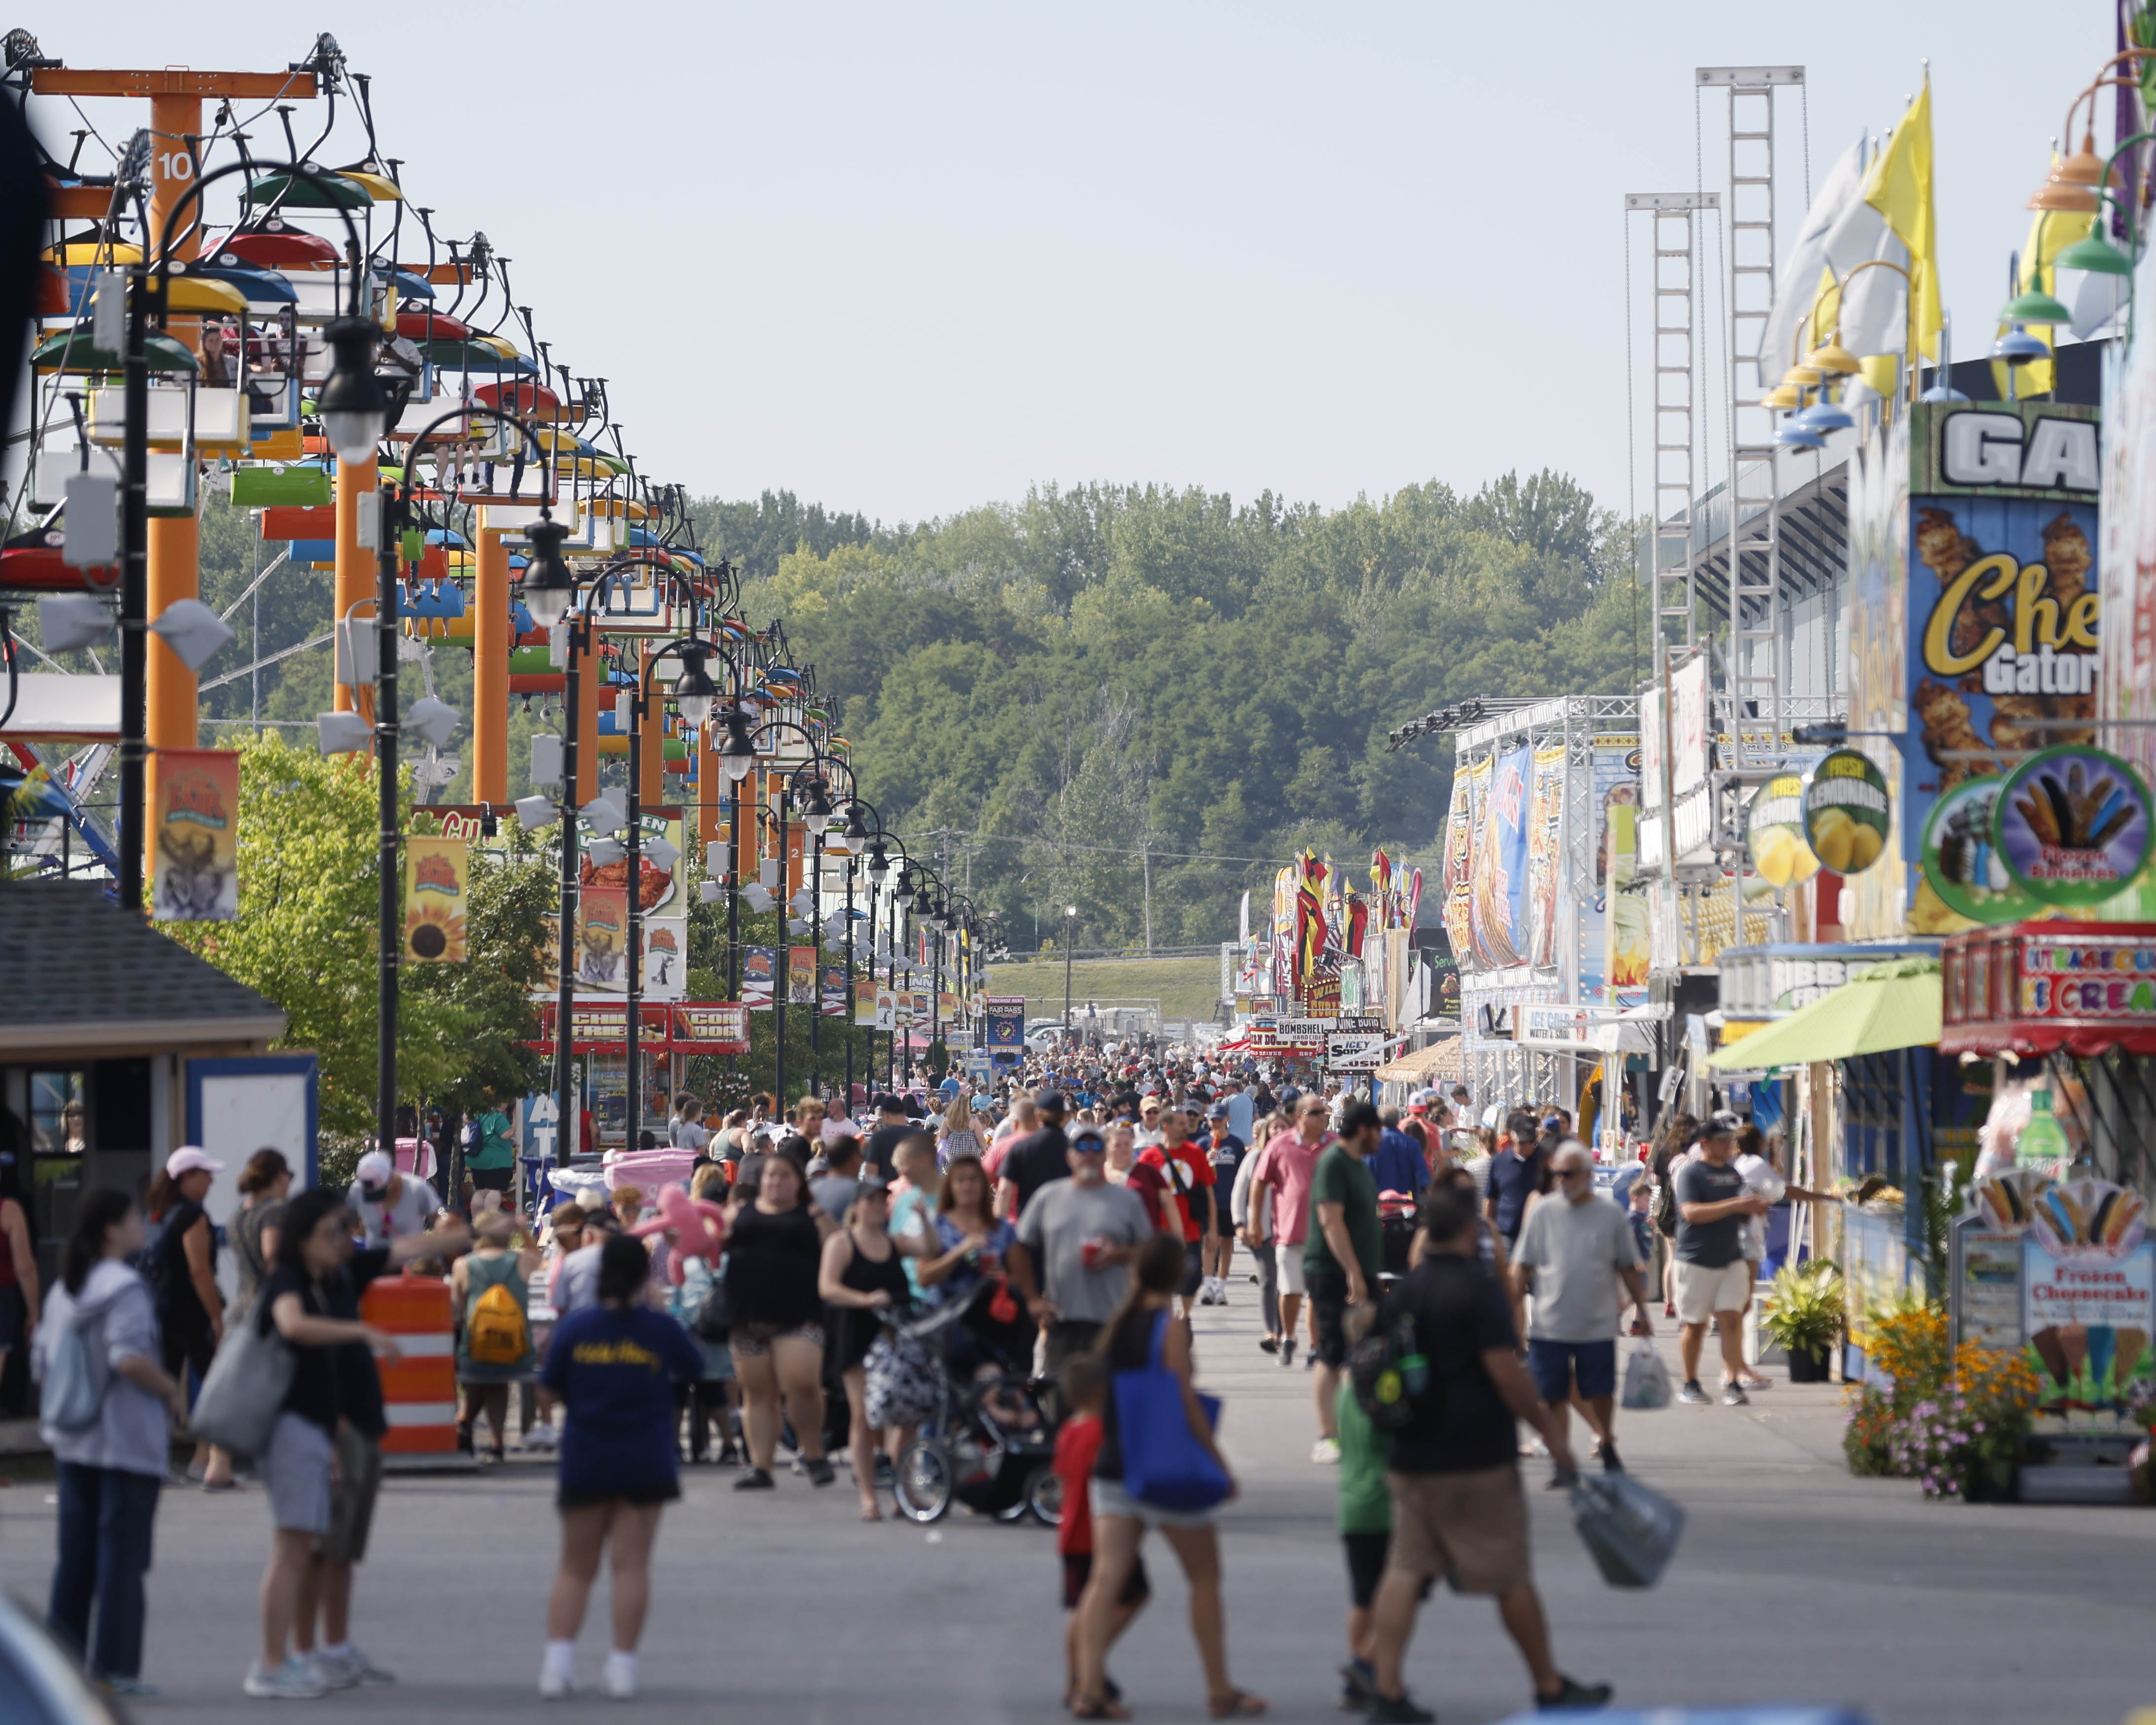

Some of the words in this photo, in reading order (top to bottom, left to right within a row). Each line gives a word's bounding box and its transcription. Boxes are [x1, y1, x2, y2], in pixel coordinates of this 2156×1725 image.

[158, 152, 193, 180] 10
[1828, 756, 1865, 779] FRESH
[1770, 777, 1802, 798] FRES
[1808, 777, 1887, 813] LEMONADE
[1749, 796, 1802, 830] LEMON
[791, 848, 799, 858] 2
[2042, 846, 2108, 862] Frozen
[2031, 862, 2119, 879] Bananas
[2027, 949, 2156, 971] OUTRAGEOU
[1312, 983, 1340, 999] WILD
[2060, 980, 2156, 1012] CREA
[1310, 1001, 1341, 1017] CURL
[572, 1014, 636, 1024] CHIL
[691, 1013, 741, 1024] CORN
[1531, 1012, 1545, 1027] ICE
[695, 1025, 740, 1036] DOGS
[1279, 1024, 1325, 1034] BOMBSHELL
[1530, 1029, 1548, 1038] WATER
[1555, 1029, 1570, 1039] SODA
[2055, 1268, 2126, 1283] Frozen
[2033, 1285, 2150, 1302] Cheesecake
